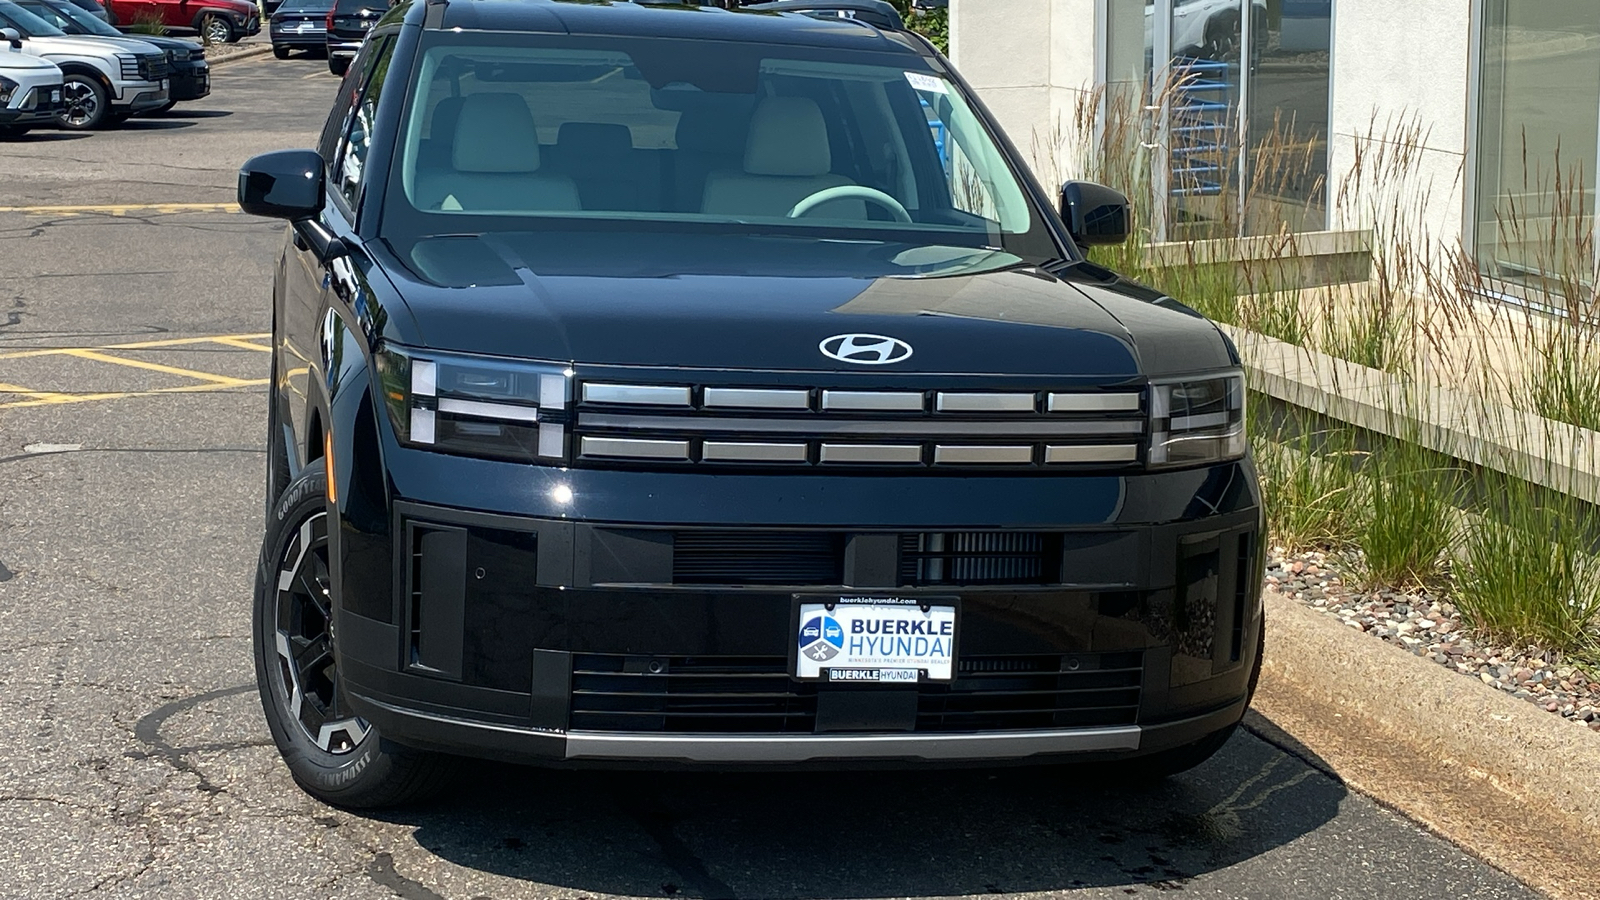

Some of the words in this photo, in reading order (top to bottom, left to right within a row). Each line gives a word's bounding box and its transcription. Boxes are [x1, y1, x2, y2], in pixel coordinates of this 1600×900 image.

[839, 597, 917, 605] buerklehyundai.com
[851, 619, 953, 636] BUERKLE
[849, 636, 951, 657] HYUNDAI
[831, 669, 880, 680] BUERKLE
[881, 671, 917, 681] HYUNDAI
